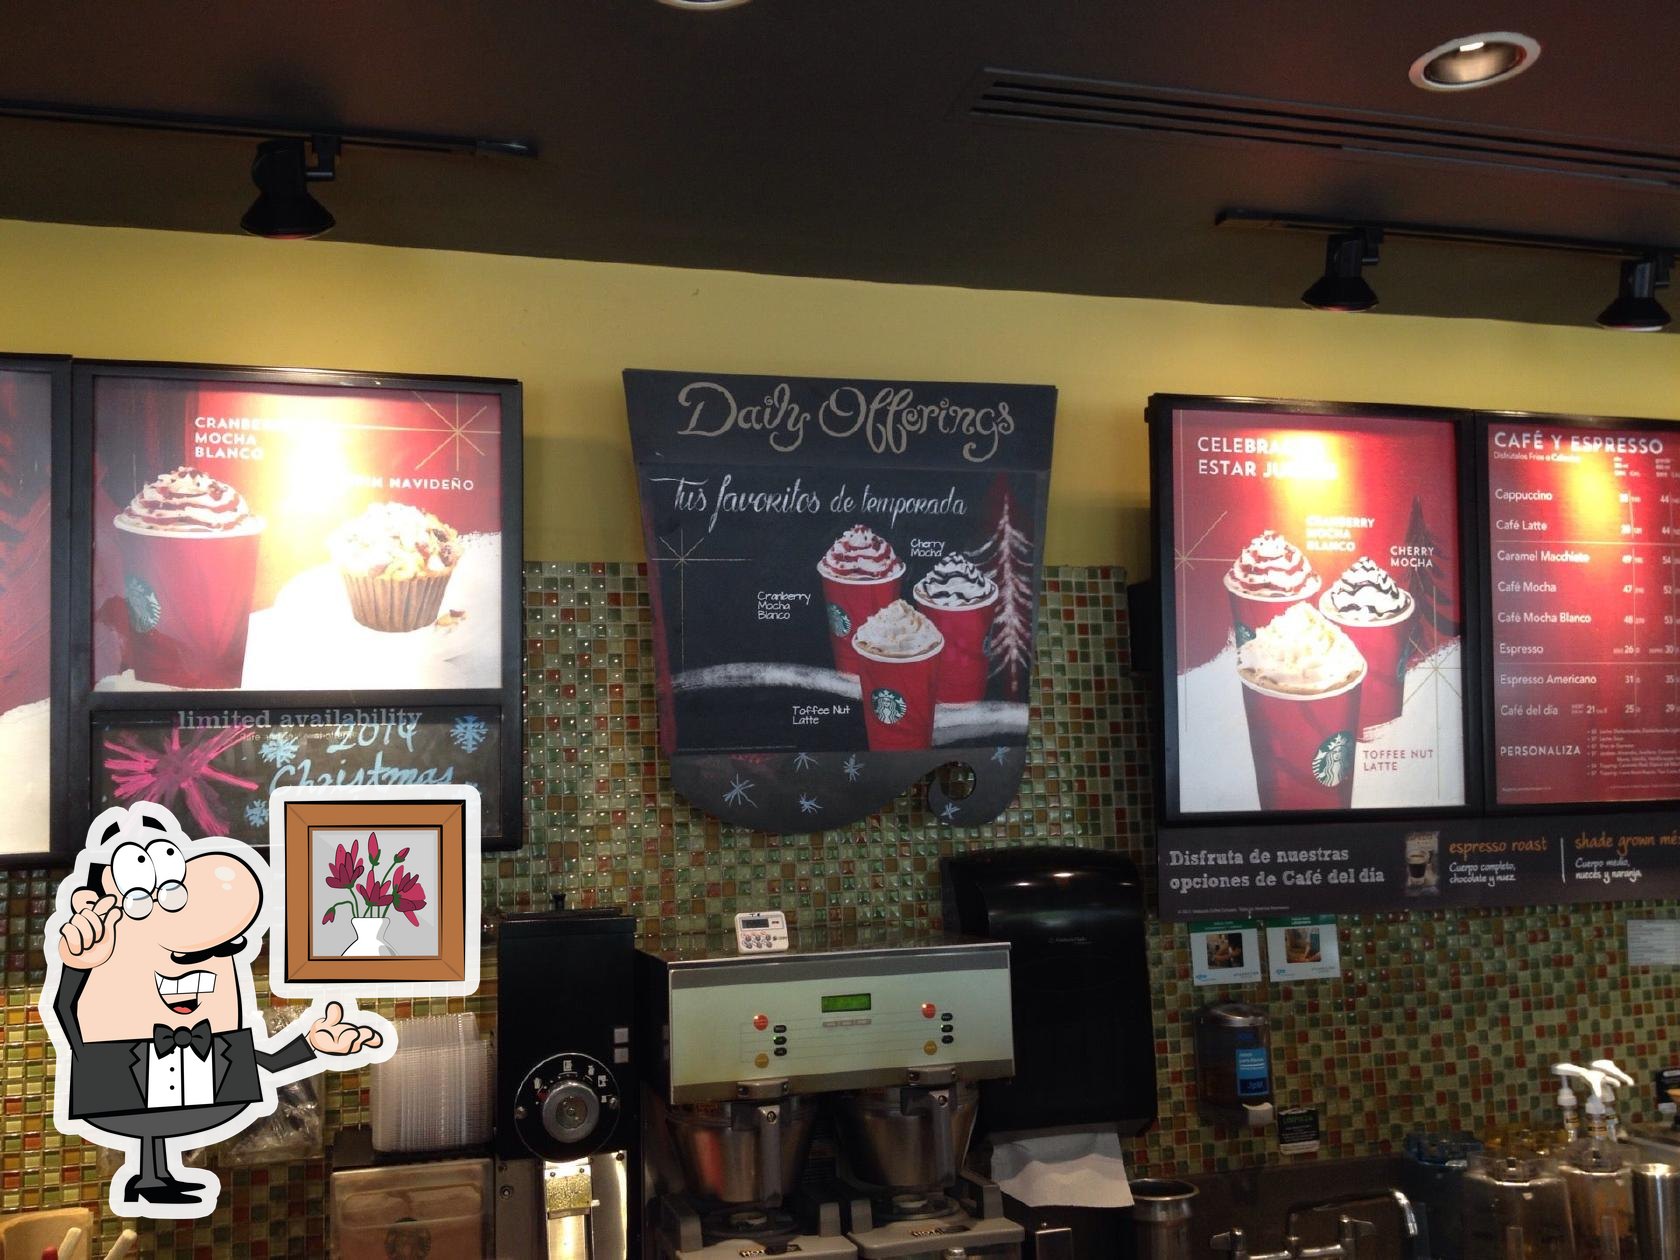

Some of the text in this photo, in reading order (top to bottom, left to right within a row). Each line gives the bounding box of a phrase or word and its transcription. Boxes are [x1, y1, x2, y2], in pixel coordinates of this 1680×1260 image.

[677, 382, 1014, 462] Daily Offerings
[195, 432, 256, 445] MOCHA
[1494, 430, 1663, 454] CAFÉ Y ESPRESSO
[195, 446, 264, 460] BLANCO
[1198, 459, 1257, 477] ESTAR
[390, 477, 474, 491] NAVIDEÑO
[1495, 488, 1553, 502] Cappuccino
[650, 474, 968, 533] Tus favoritos de temporada
[1496, 520, 1520, 531] Café
[1522, 520, 1548, 531] Latte
[910, 538, 945, 551] Cherry
[1390, 546, 1434, 556] CHERRY
[911, 548, 942, 557] Mocha
[1497, 550, 1538, 561] Caramel
[1390, 558, 1433, 568] MOCHA
[1498, 581, 1521, 592] Café
[1523, 582, 1557, 592] Mocha
[757, 591, 811, 605] Cranberry
[758, 602, 790, 611] Mocha
[758, 611, 790, 620] Blanco
[1498, 612, 1521, 623] Café
[1523, 613, 1557, 623] Mocha
[1559, 612, 1592, 624] Blanco
[1499, 643, 1544, 656] Espresso
[1500, 674, 1544, 687] Espresso
[1546, 674, 1597, 684] Americano
[793, 705, 850, 716] Toffee Nut
[1501, 704, 1523, 716] Café
[1526, 704, 1541, 716] del
[179, 708, 422, 730] limited availability
[793, 715, 819, 725] Latte
[1363, 749, 1433, 759] TOFFEE NUT
[1500, 745, 1581, 757] PERSONALIZA
[1363, 762, 1398, 771] LATTE
[1449, 838, 1547, 862] espresso roast
[1575, 832, 1613, 850] shade
[1617, 835, 1655, 857] grown
[1169, 848, 1349, 866] Disfruta de nuestras
[1575, 857, 1604, 870] Cuerpo
[1449, 862, 1479, 875] Cuerpo
[1169, 867, 1385, 894] opciones de Café del día
[1449, 873, 1487, 884] chocolate
[1488, 875, 1495, 887] y
[1576, 869, 1601, 880] nueces
[1603, 872, 1610, 884] y
